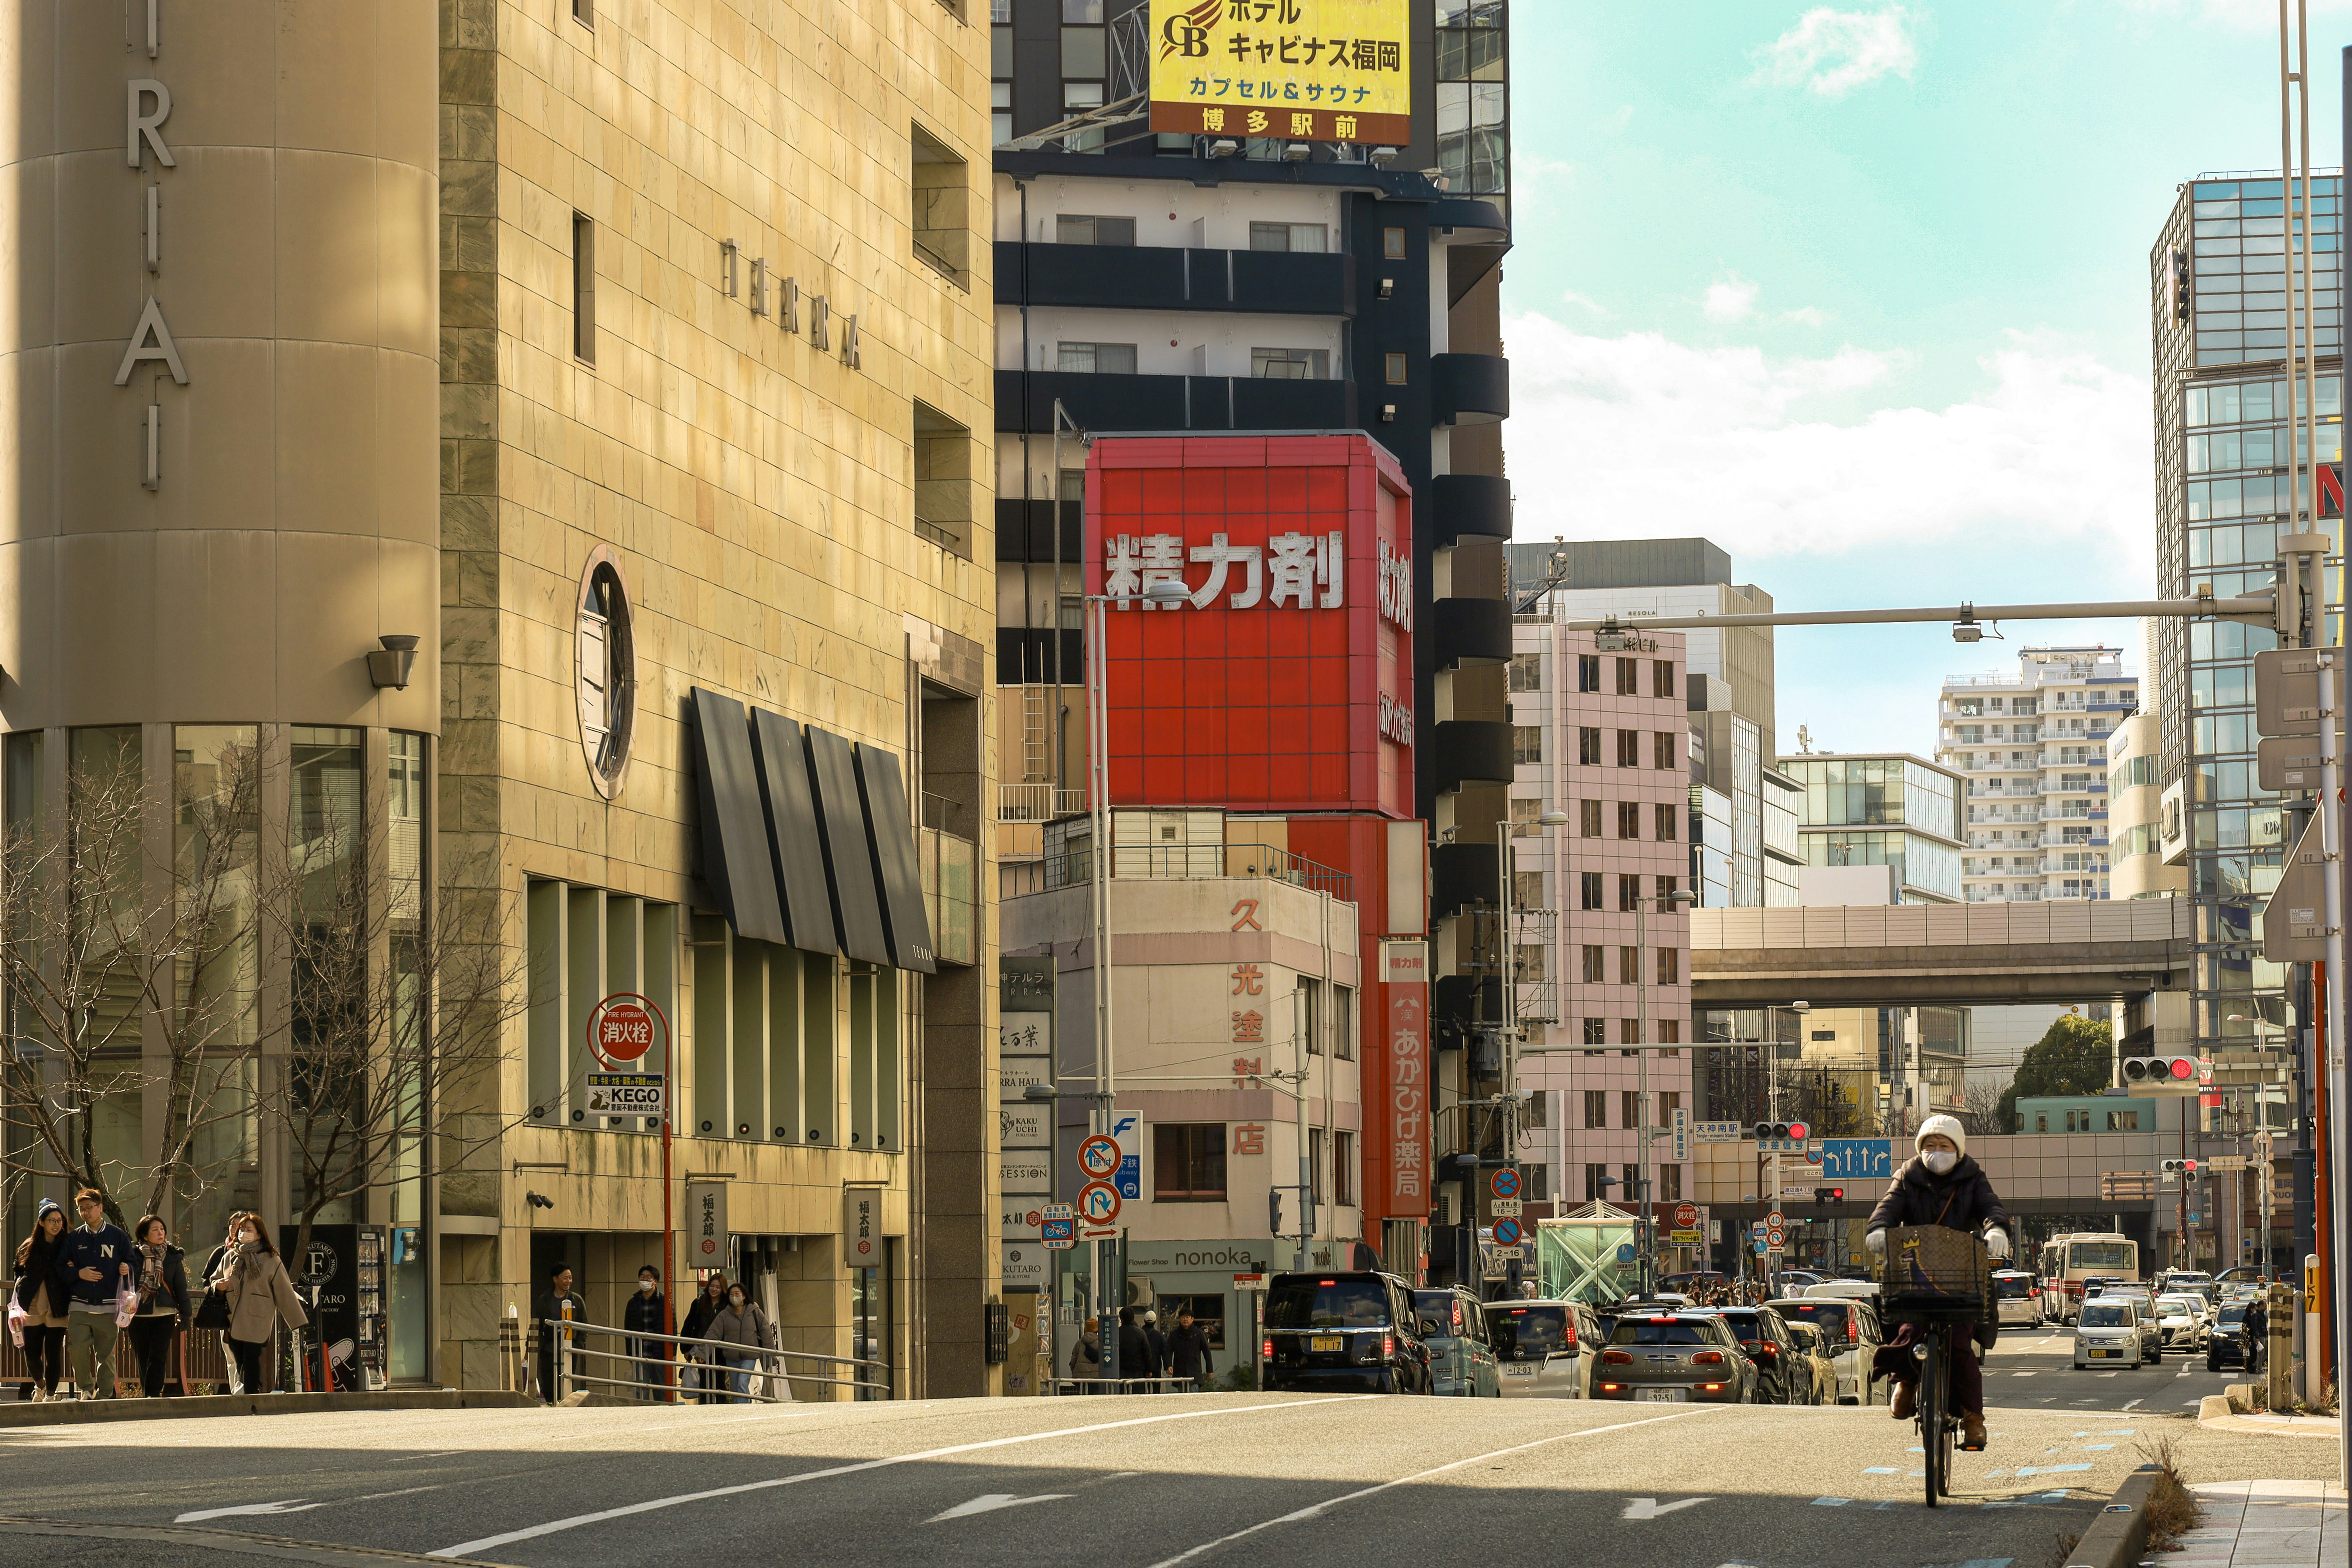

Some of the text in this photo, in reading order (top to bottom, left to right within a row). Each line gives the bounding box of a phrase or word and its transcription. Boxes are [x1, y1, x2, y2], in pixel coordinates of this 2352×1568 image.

[1229, 0, 1301, 24] ホテル
[1229, 33, 1401, 72] キャビナス福岡
[1190, 78, 1371, 104] カプセル&サウナ
[1202, 108, 1358, 139] 博多駅前
[726, 238, 861, 370] TERRA
[1105, 531, 1343, 611] 精力剤
[1379, 537, 1411, 633] 精力剤
[1390, 958, 1423, 969] 精力剤
[1000, 972, 1044, 983] 神テルラ
[1401, 1009, 1413, 1021] 漢
[603, 1021, 649, 1043] 消火栓
[1231, 899, 1265, 1154] 久光塗料店
[611, 1088, 659, 1103] KEGO
[1394, 1028, 1422, 1197] あかひげ薬局
[1696, 1124, 1738, 1133] 天神南駅
[1758, 1141, 1803, 1150] 時差信号
[1093, 1158, 1112, 1167] 原付
[1121, 1158, 1137, 1168] 下鉄
[1001, 1169, 1047, 1178] SESSION
[702, 1193, 714, 1237] 福太郎
[858, 1201, 870, 1239] 福太郎
[1002, 1212, 1023, 1225] 太郎
[1677, 1211, 1695, 1220] 消火栓
[101, 1244, 114, 1258] N
[308, 1243, 332, 1255] KUTARO
[1175, 1247, 1251, 1265] nonoka
[311, 1274, 331, 1284] HAKATA
